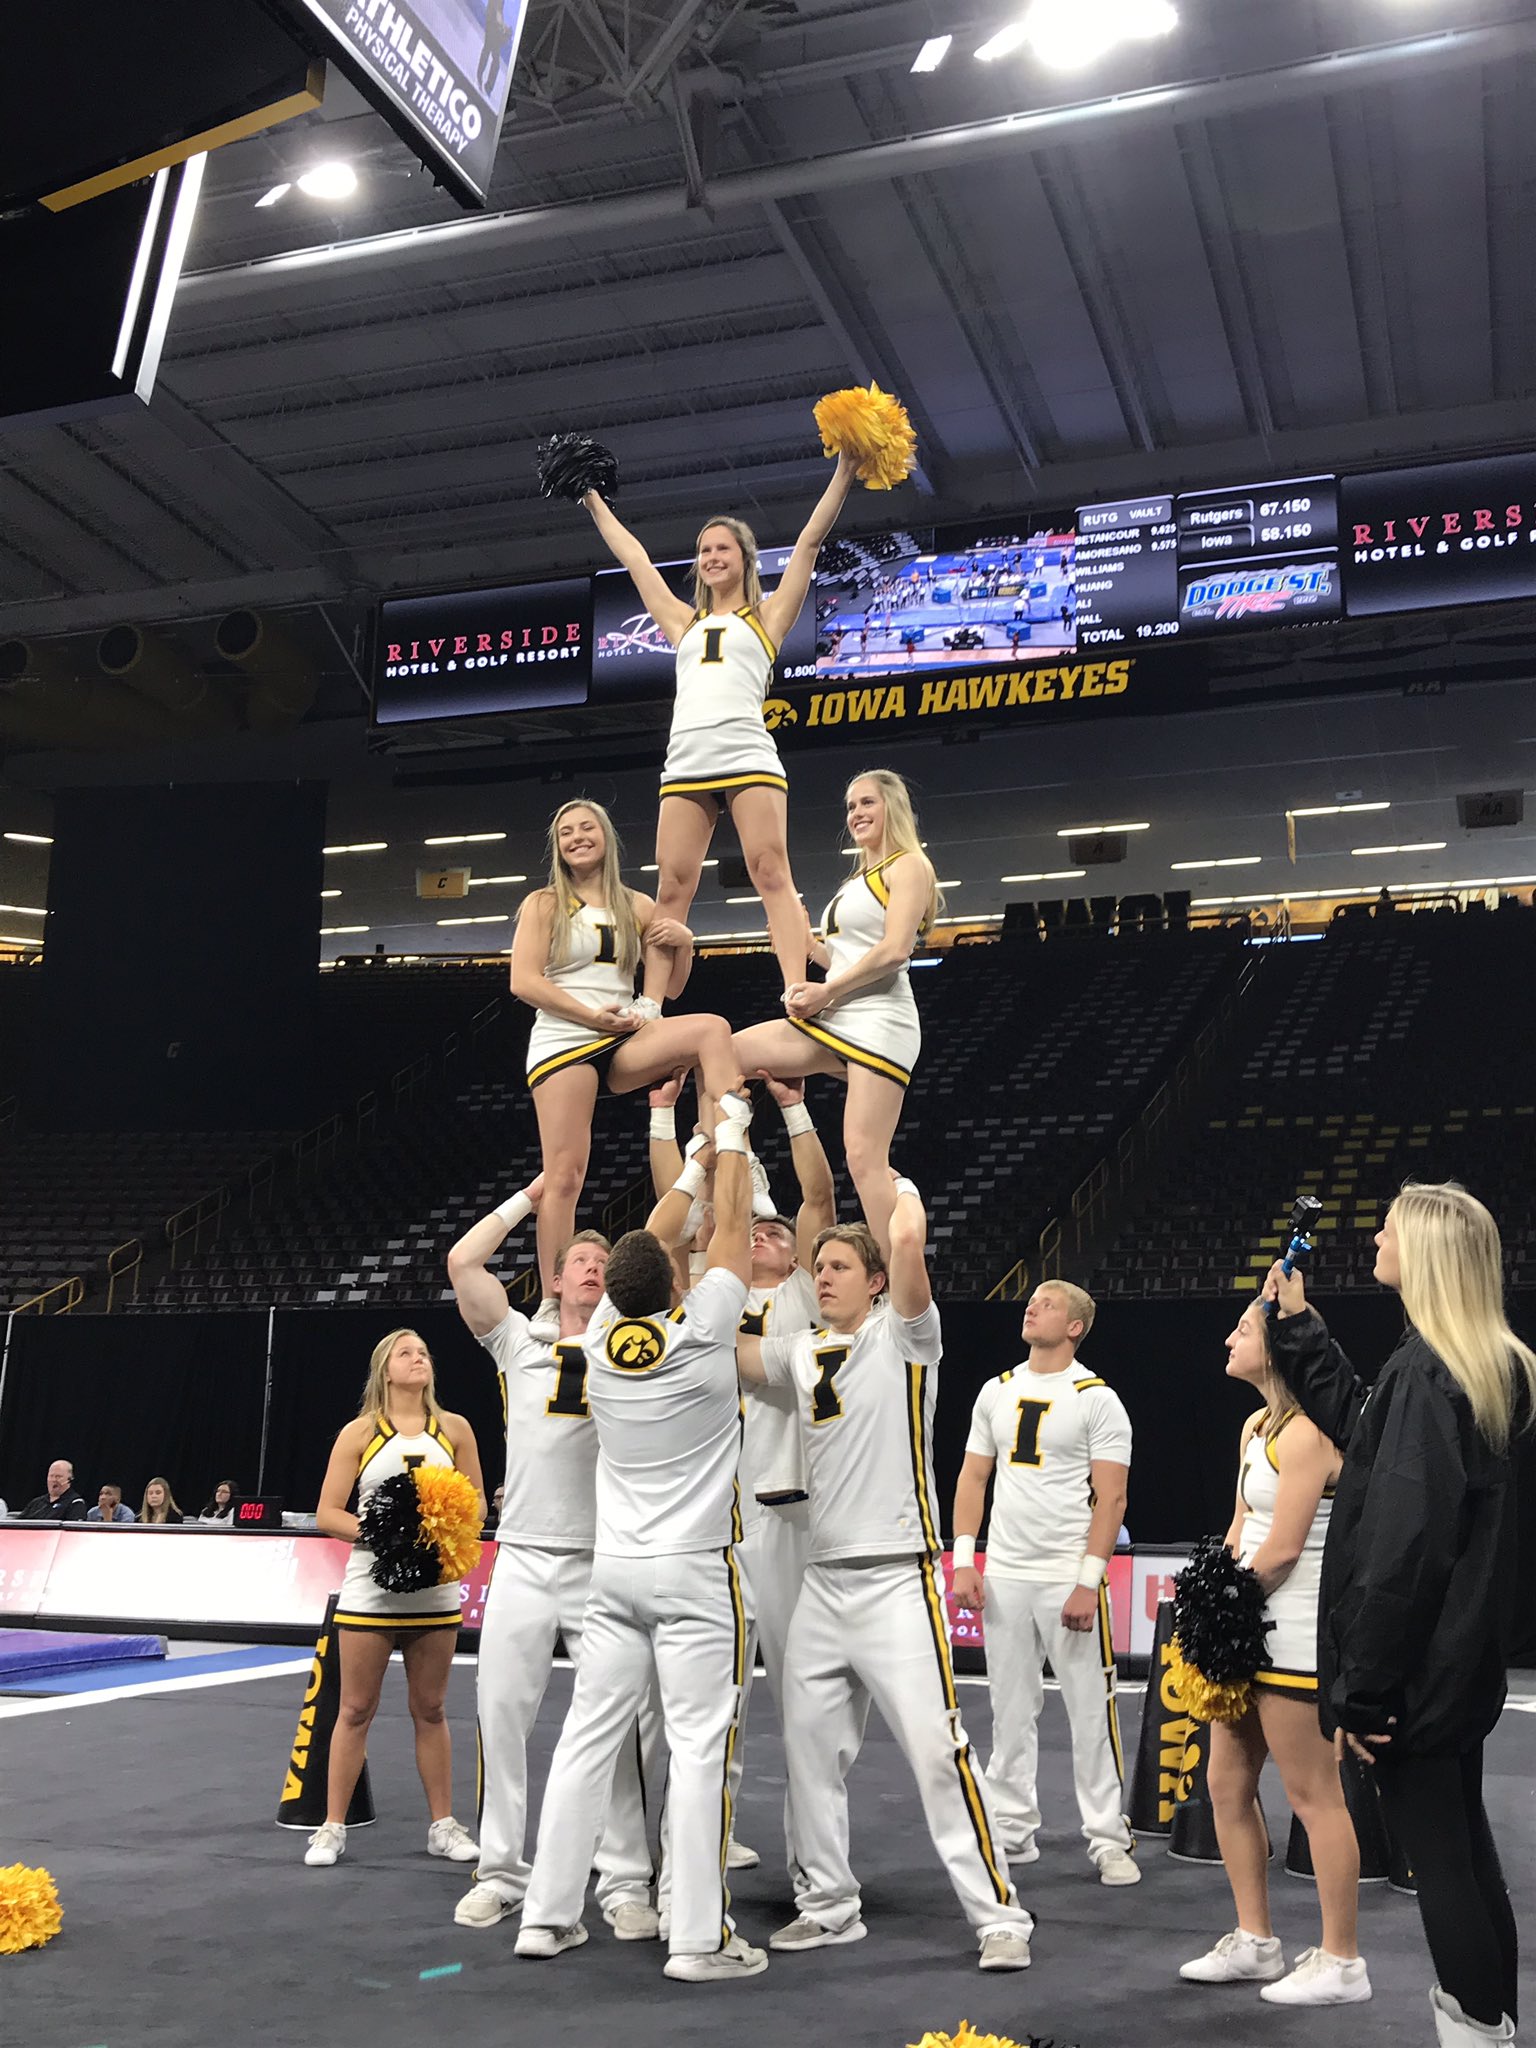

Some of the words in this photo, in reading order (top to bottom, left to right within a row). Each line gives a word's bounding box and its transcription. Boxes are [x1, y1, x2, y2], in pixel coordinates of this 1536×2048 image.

[344, 6, 410, 92] PHYSICAL
[410, 81, 469, 155] THERAPY
[352, 0, 483, 141] THLETICO
[1083, 511, 1119, 527] RUTG
[1128, 505, 1163, 520] VAULT
[1190, 507, 1244, 526] Rutgers
[1259, 498, 1311, 517] 67.150
[1351, 504, 1536, 546] RIVERS
[1075, 528, 1141, 546] BETANCOUR
[1201, 534, 1233, 549] Iowa
[1260, 523, 1312, 542] 58.150
[1354, 543, 1426, 564] HOTEL
[1435, 540, 1450, 554] &
[1459, 531, 1519, 551] GOLF
[1075, 562, 1125, 577] WILLIAMS
[1075, 580, 1113, 594] HUANG
[1075, 598, 1092, 610] ALI
[1075, 613, 1103, 626] HALL
[386, 623, 581, 662] RIVERSIDE
[700, 626, 728, 664] I
[1082, 628, 1125, 644] TOTAL
[1135, 621, 1180, 639] 19.200
[385, 662, 440, 678] HOTEL
[447, 659, 458, 672] &
[464, 654, 508, 669] GOLF
[516, 646, 581, 663] RESORT
[806, 686, 906, 727] IOWA
[917, 658, 1133, 716] HAWKEYES
[811, 1346, 851, 1425] I
[1009, 1396, 1054, 1469] I
[281, 1635, 329, 1803] IOWA
